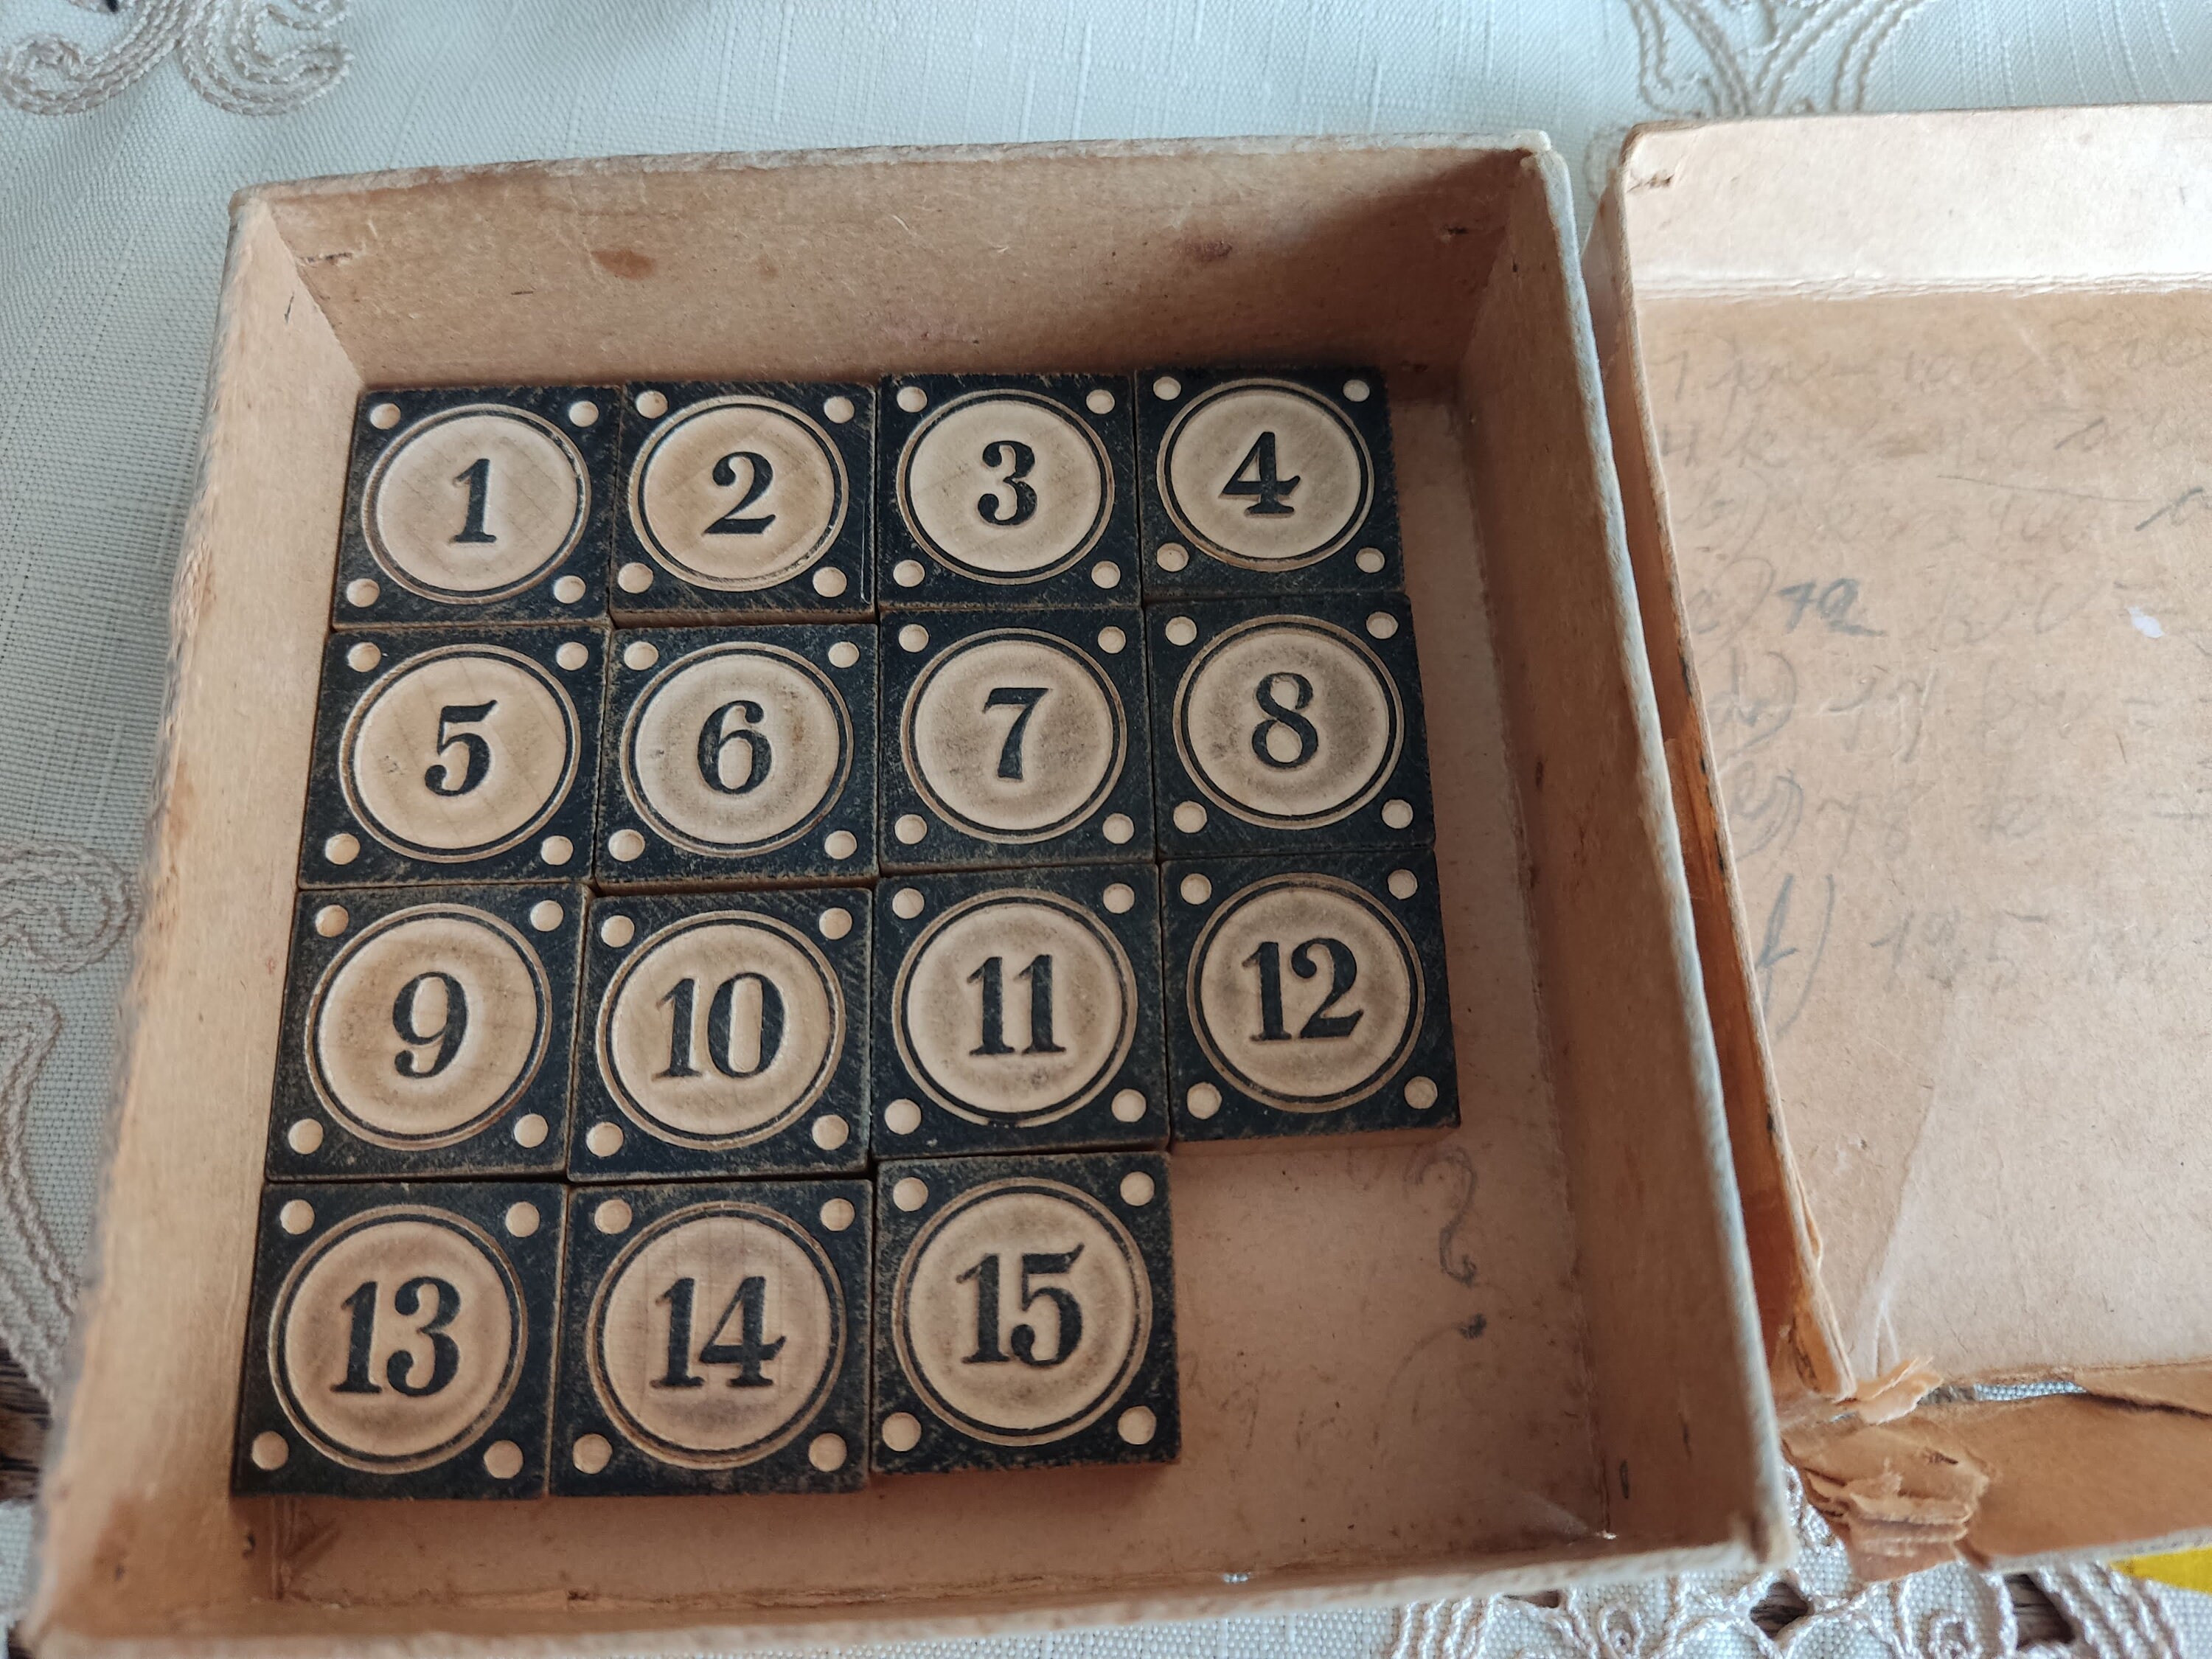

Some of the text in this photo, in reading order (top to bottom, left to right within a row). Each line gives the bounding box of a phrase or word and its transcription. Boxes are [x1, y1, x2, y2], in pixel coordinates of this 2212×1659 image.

[450, 459, 496, 543] 1
[703, 451, 776, 534] 2
[977, 440, 1037, 526] 3
[1220, 431, 1301, 518] 4
[424, 700, 496, 796] 5
[697, 700, 771, 795] 6
[982, 687, 1048, 782] 7
[1251, 672, 1318, 768] 8
[392, 972, 467, 1079] 9
[655, 972, 784, 1079] 10
[967, 954, 1066, 1057] 11
[1242, 937, 1364, 1040] 12
[329, 1276, 460, 1399] 13
[650, 1276, 786, 1391] 14
[956, 1243, 1085, 1368] 15
